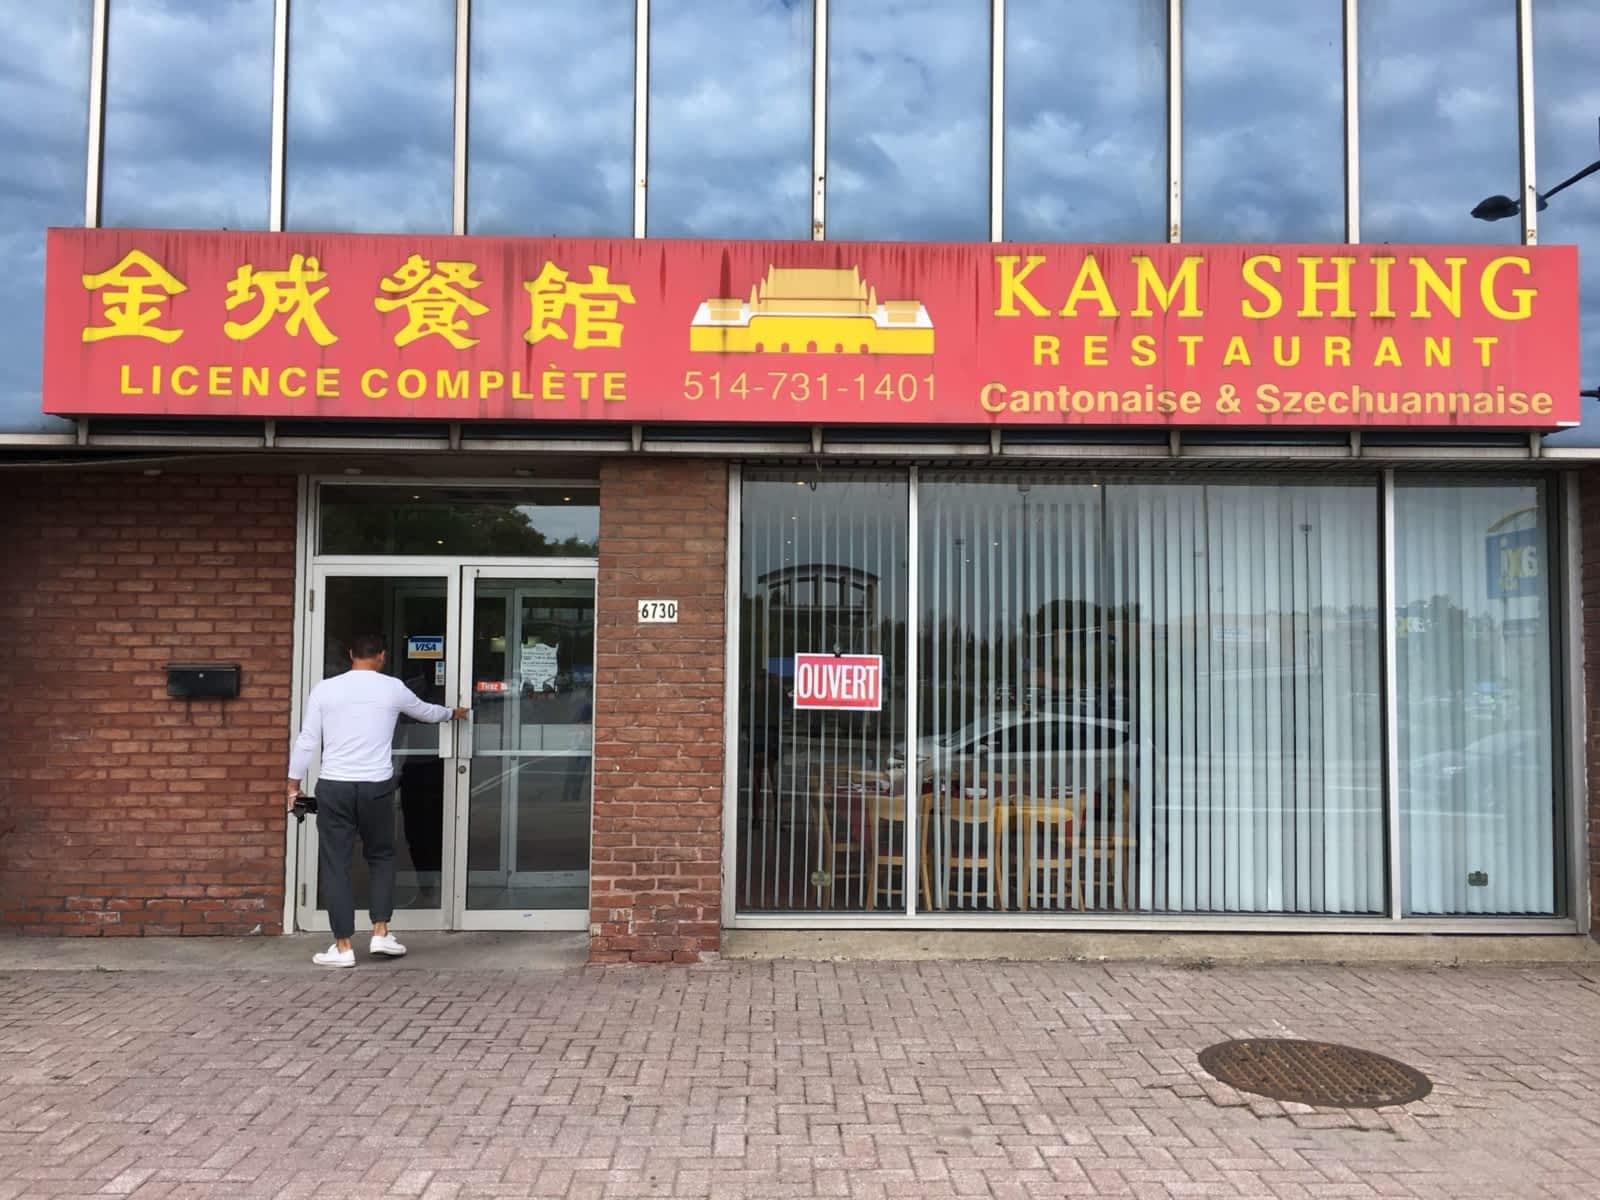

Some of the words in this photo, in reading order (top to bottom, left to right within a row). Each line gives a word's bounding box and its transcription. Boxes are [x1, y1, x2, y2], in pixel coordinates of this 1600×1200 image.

[82, 250, 636, 350] 金城餐館
[994, 255, 1204, 318] KAM
[1241, 255, 1538, 321] SHING
[1033, 334, 1499, 368] RESTAURANT
[120, 364, 341, 398] LICENCE
[360, 363, 627, 401] COMPLÈTE
[684, 370, 936, 404] 514-731-1401
[980, 382, 1202, 414] Cantonaise
[1215, 383, 1242, 414] &
[1256, 383, 1553, 415] Szechuannaise
[641, 602, 676, 619] 6730
[415, 643, 437, 652] VISA
[798, 663, 878, 700] OUVERT
